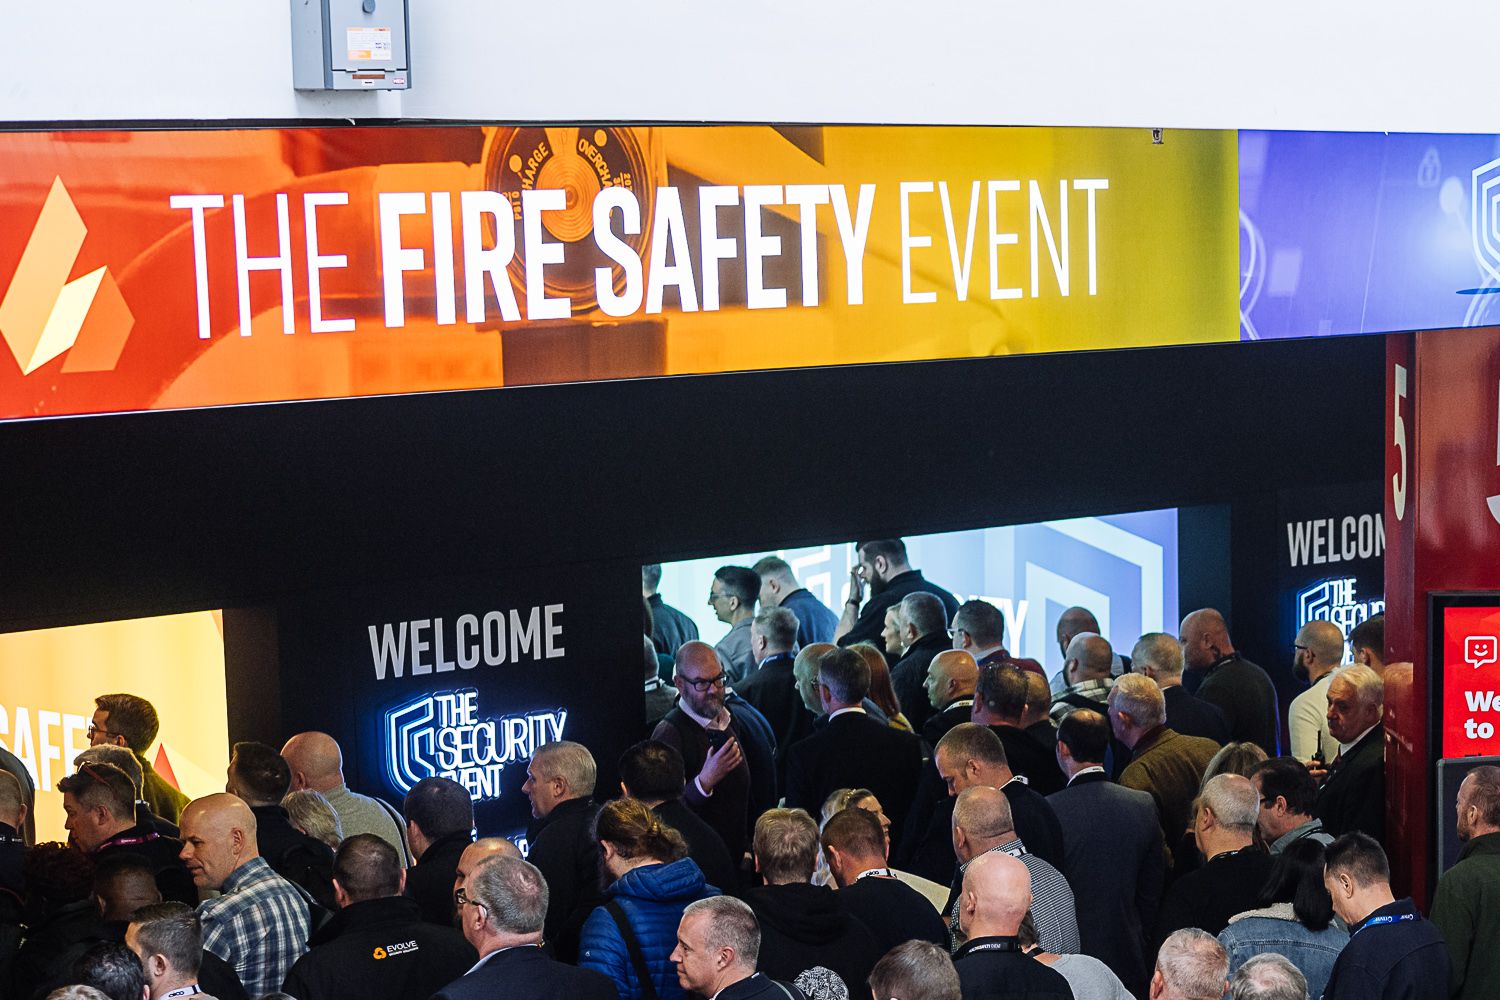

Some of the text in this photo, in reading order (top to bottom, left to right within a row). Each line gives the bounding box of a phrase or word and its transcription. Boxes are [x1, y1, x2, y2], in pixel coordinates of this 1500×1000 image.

[170, 179, 1109, 340] THE FIRE SAFETY EVENT
[1395, 364, 1408, 521] 5
[1329, 578, 1357, 607] THE
[368, 603, 565, 681] WELCOME
[433, 690, 478, 729] THE
[1464, 718, 1495, 740] to
[0, 703, 93, 792] AFE
[436, 710, 568, 771] SECURITY
[386, 940, 418, 953] EVOLVE
